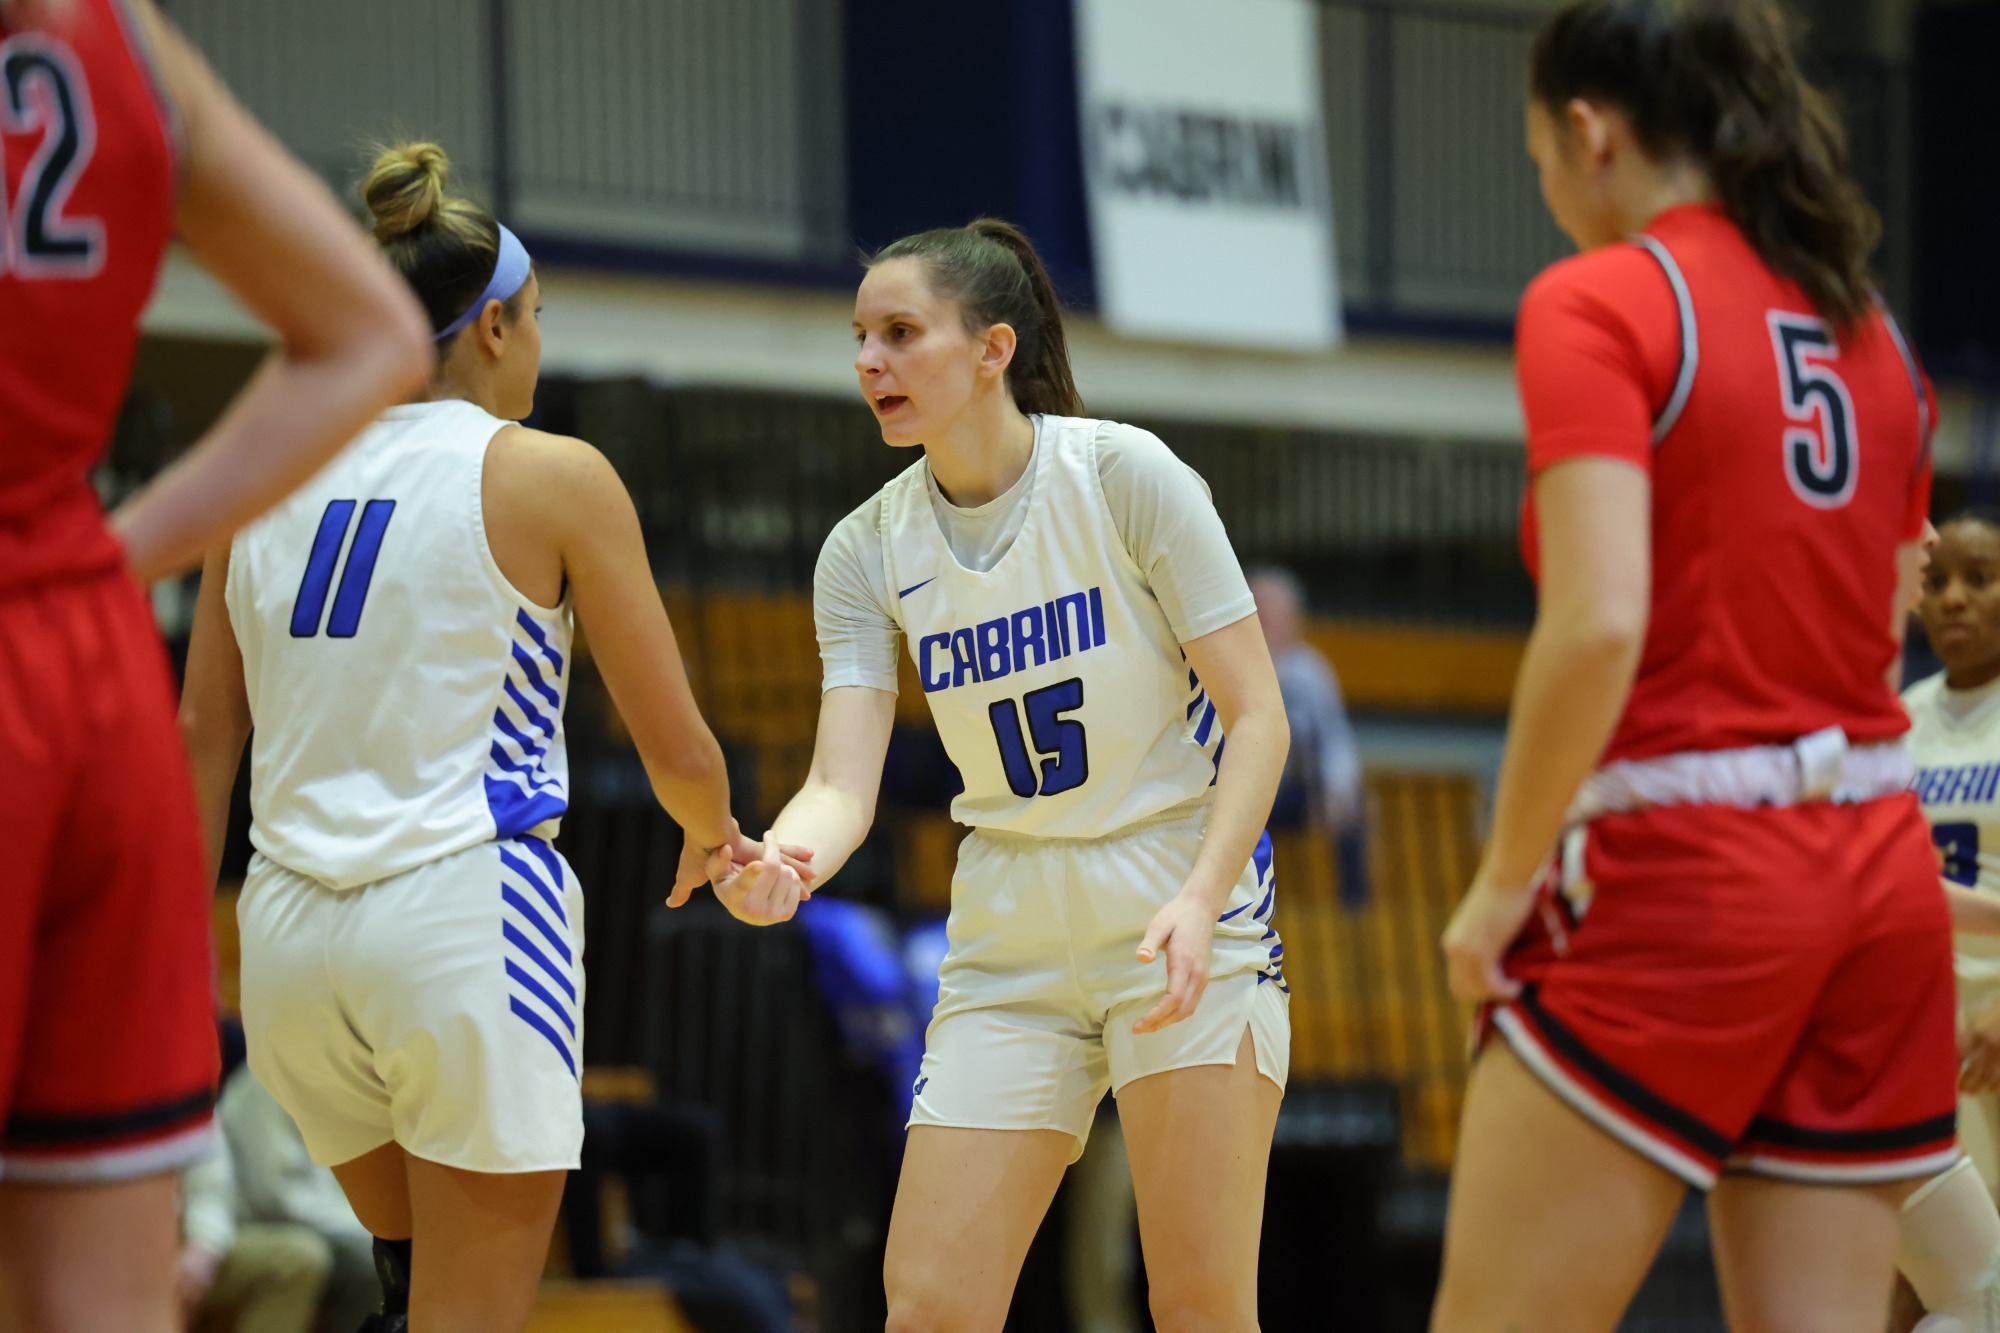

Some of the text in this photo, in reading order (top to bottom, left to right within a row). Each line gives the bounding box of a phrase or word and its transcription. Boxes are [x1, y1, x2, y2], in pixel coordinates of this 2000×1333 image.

[0, 32, 107, 280] 2
[1766, 308, 1860, 510] 5
[290, 498, 396, 637] 11
[919, 586, 1106, 693] CABRINI
[989, 677, 1089, 799] 15
